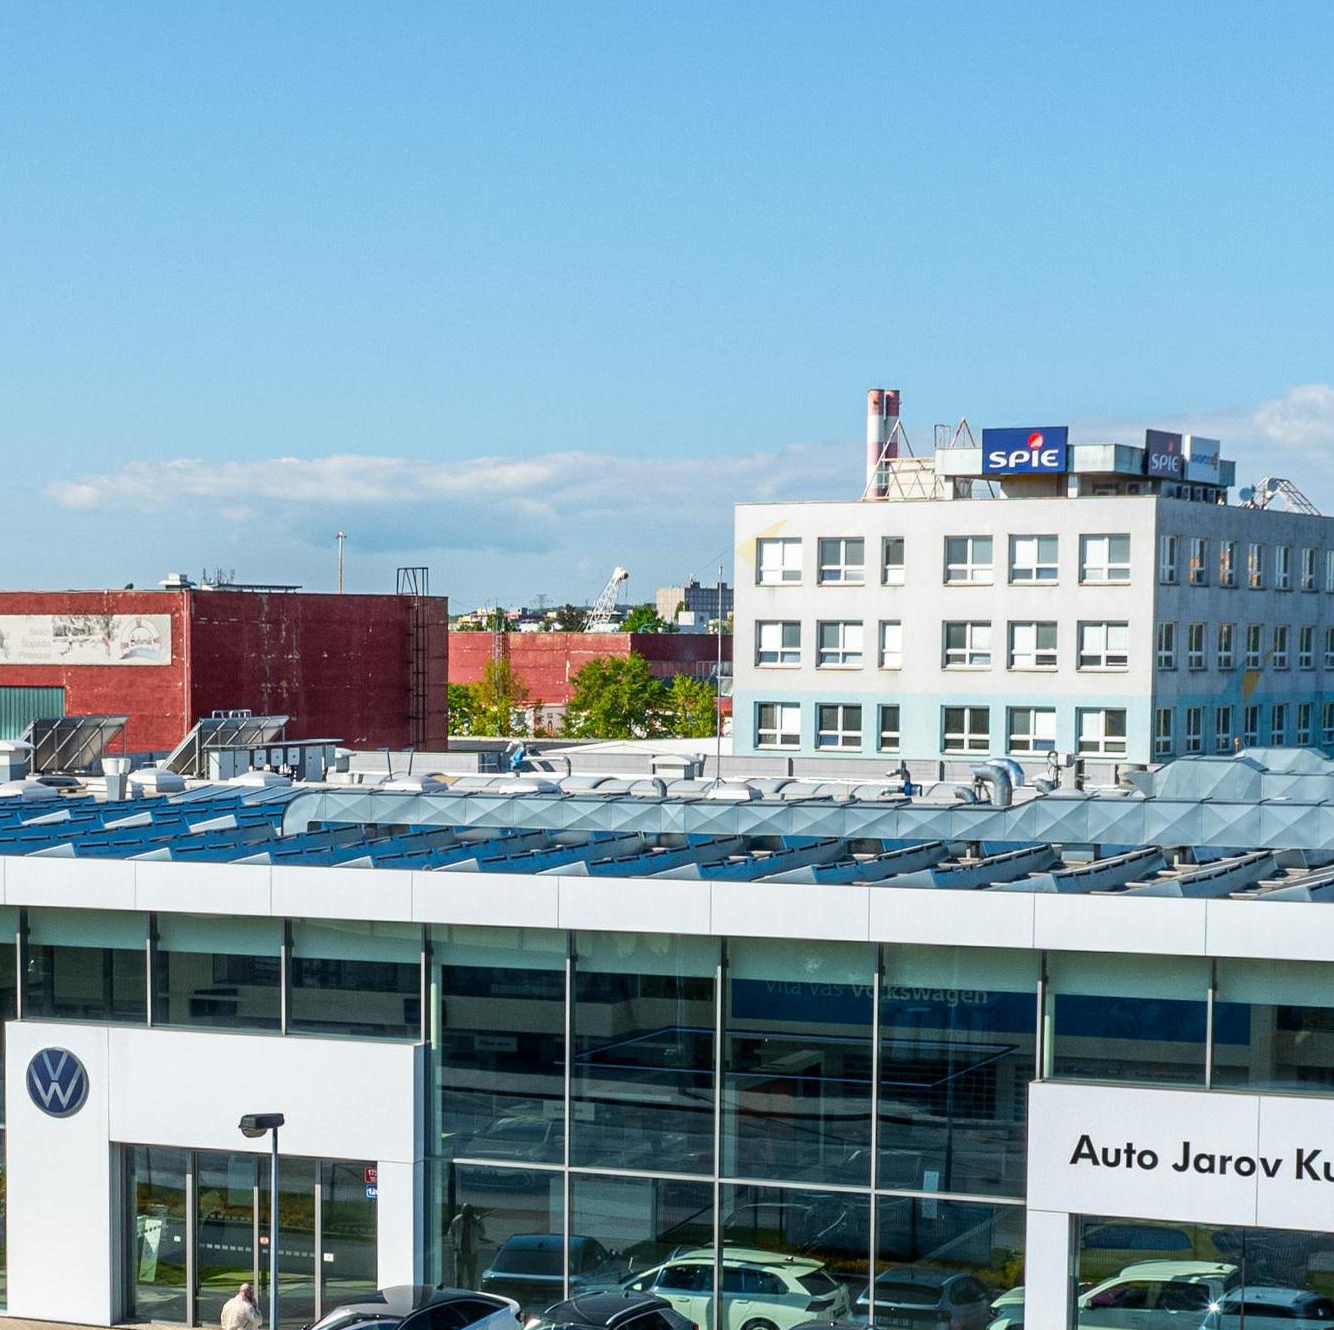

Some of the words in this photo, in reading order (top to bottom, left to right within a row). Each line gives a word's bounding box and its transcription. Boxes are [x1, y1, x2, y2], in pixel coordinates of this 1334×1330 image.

[988, 449, 1059, 469] SPIE
[1151, 452, 1179, 472] SPIE
[1069, 1134, 1158, 1170] Auto
[1171, 1141, 1283, 1178] Jarov
